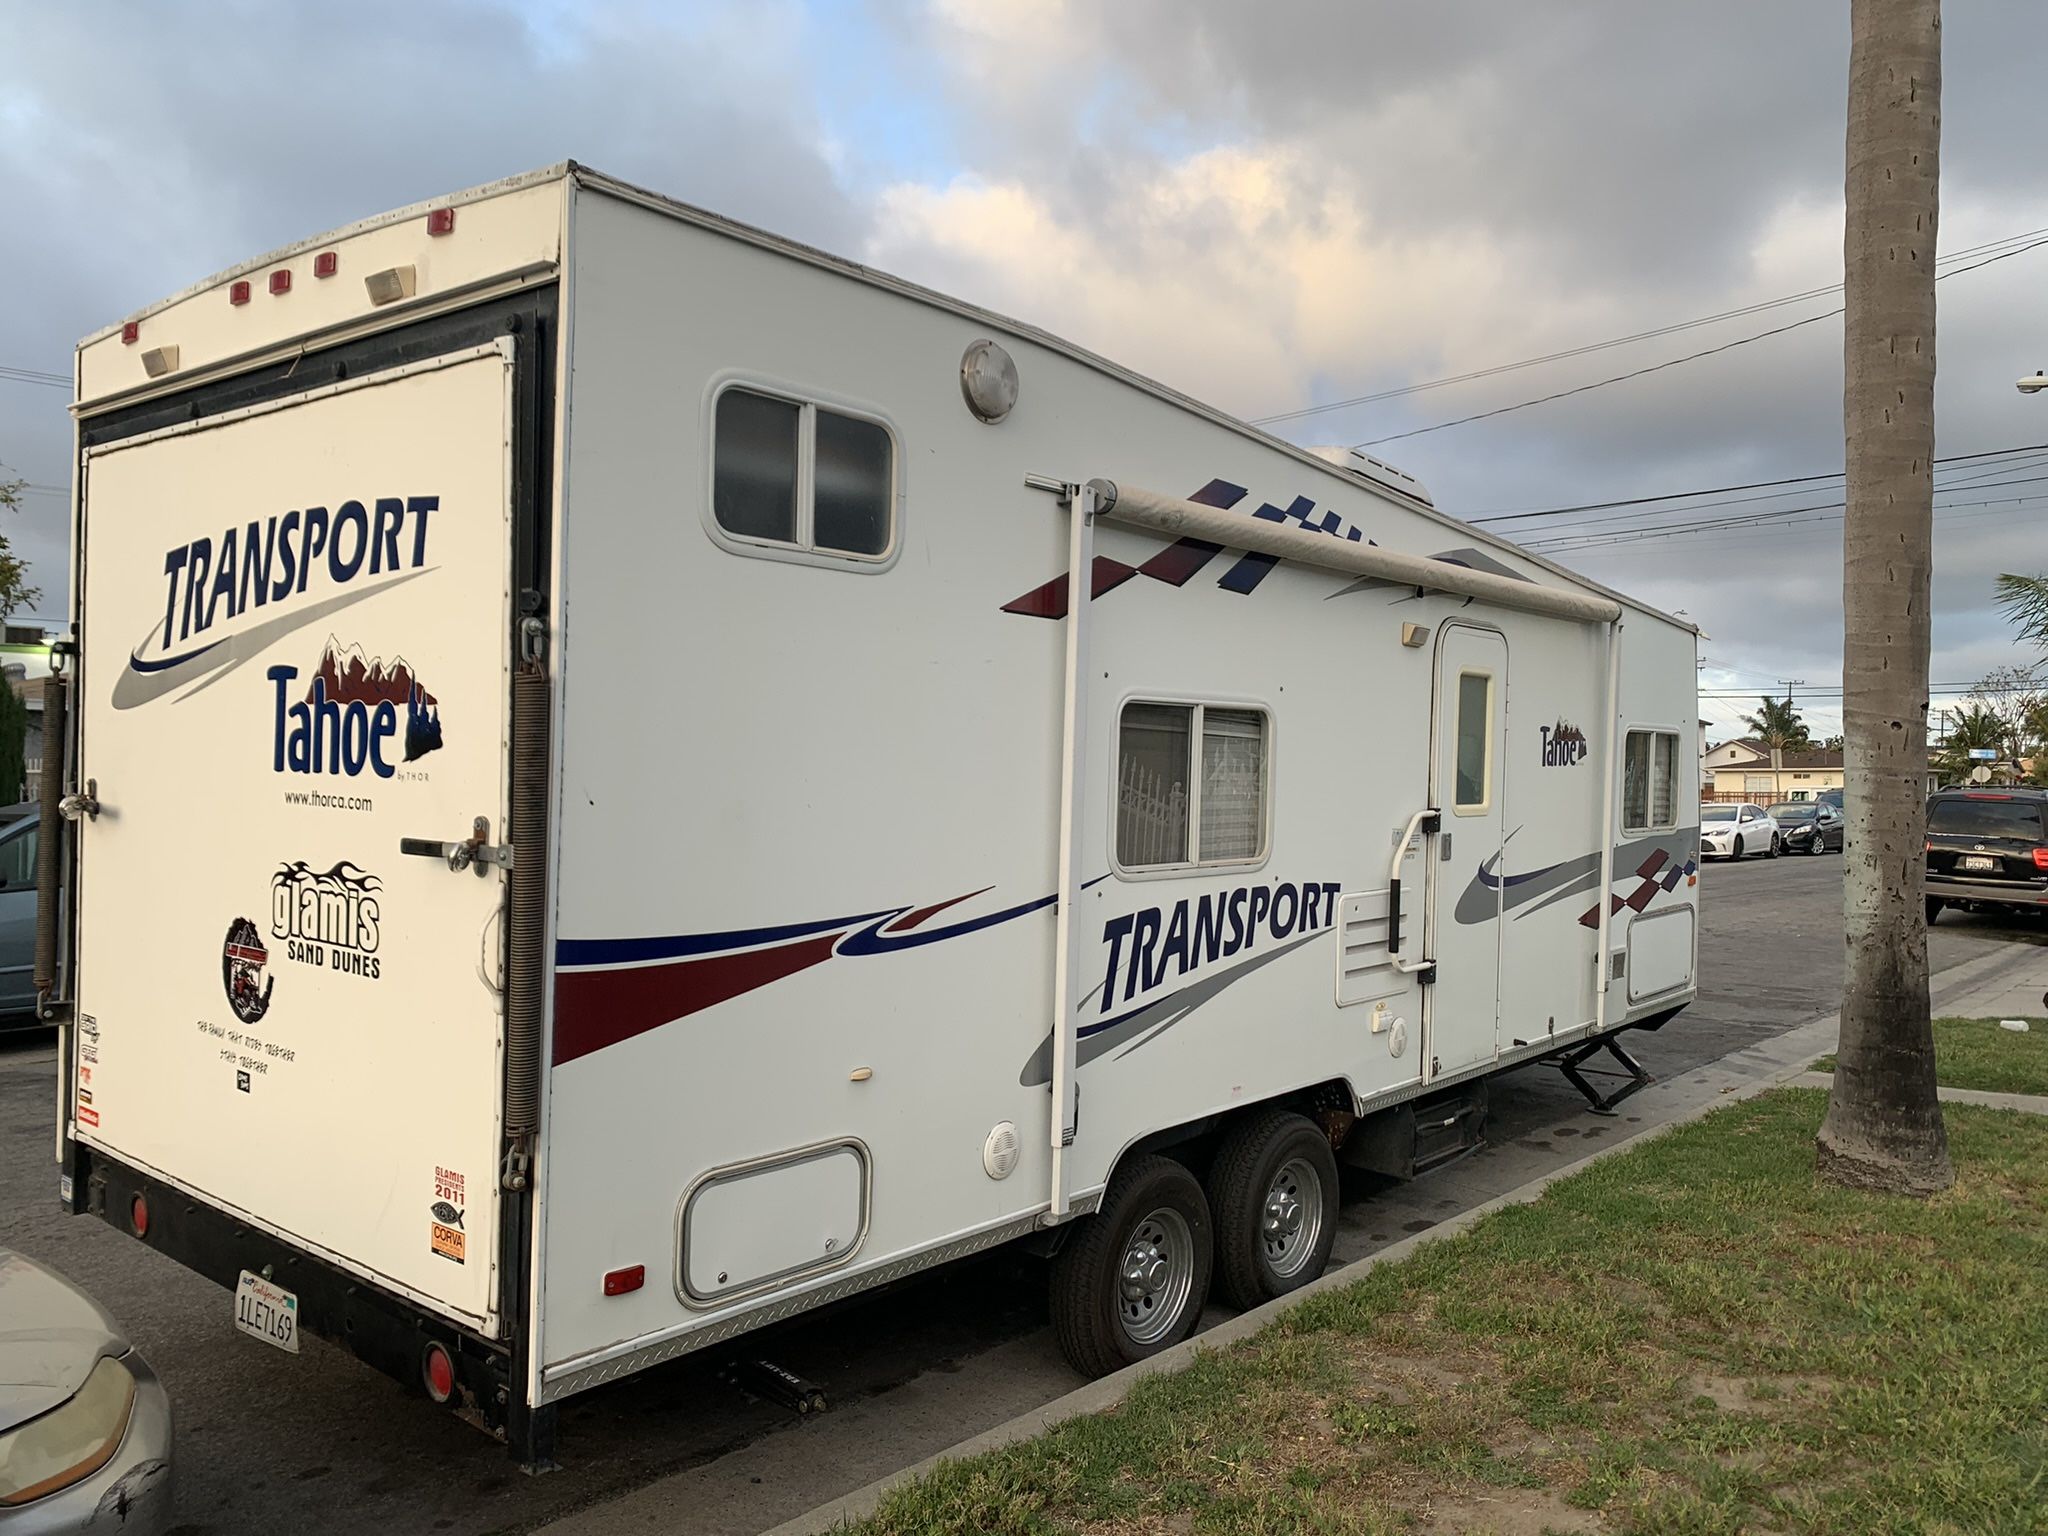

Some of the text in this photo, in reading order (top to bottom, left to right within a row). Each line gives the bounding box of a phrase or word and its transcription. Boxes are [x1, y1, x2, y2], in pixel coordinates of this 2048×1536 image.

[162, 496, 440, 651] TRANSPORT
[267, 665, 397, 778] Tahoe
[1540, 726, 1576, 767] Tahoe
[406, 771, 430, 782] THOR
[284, 789, 372, 811] www.thorca.com
[271, 880, 380, 953] glamis
[287, 940, 324, 966] SAND
[332, 949, 380, 979] DUNES
[1100, 882, 1341, 1014] TRANSPORT
[435, 1166, 465, 1185] GLAMIS
[435, 1176, 465, 1193] PRESIDENTS
[435, 1184, 465, 1206] 2011
[433, 1225, 463, 1249] CORVA
[238, 1294, 292, 1343] 1LE7169
